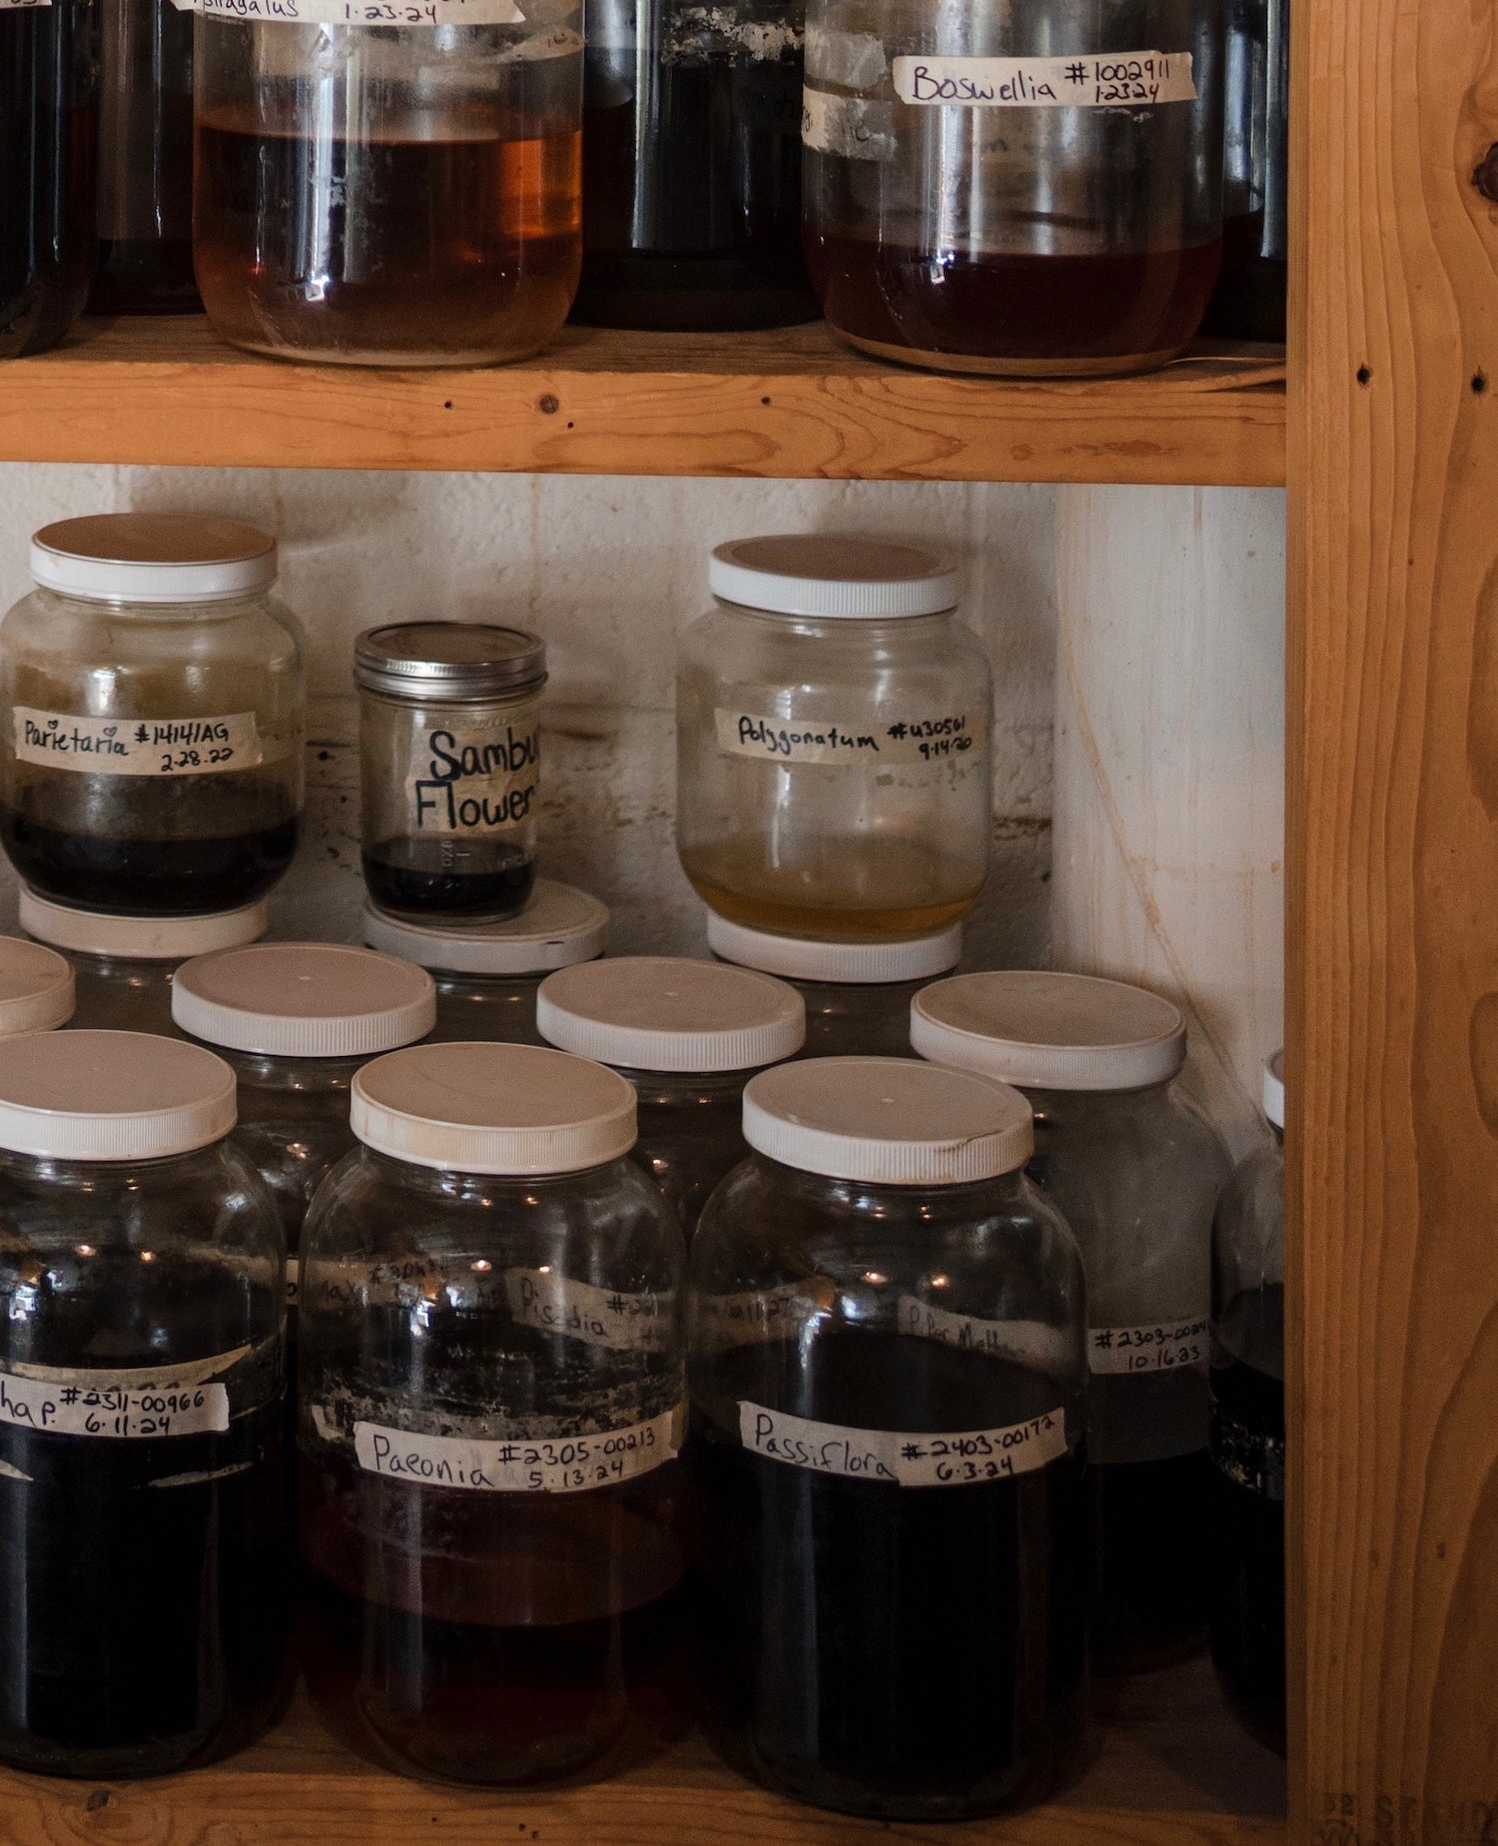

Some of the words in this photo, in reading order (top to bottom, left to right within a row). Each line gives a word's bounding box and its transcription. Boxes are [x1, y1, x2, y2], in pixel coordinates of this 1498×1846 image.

[911, 65, 1058, 103] Boswellia
[24, 718, 130, 757] Parietaria
[738, 714, 880, 756] Polygonatum
[414, 779, 536, 830] Flower
[373, 1433, 493, 1488] Paeonia
[754, 1411, 896, 1477] Passiflora
